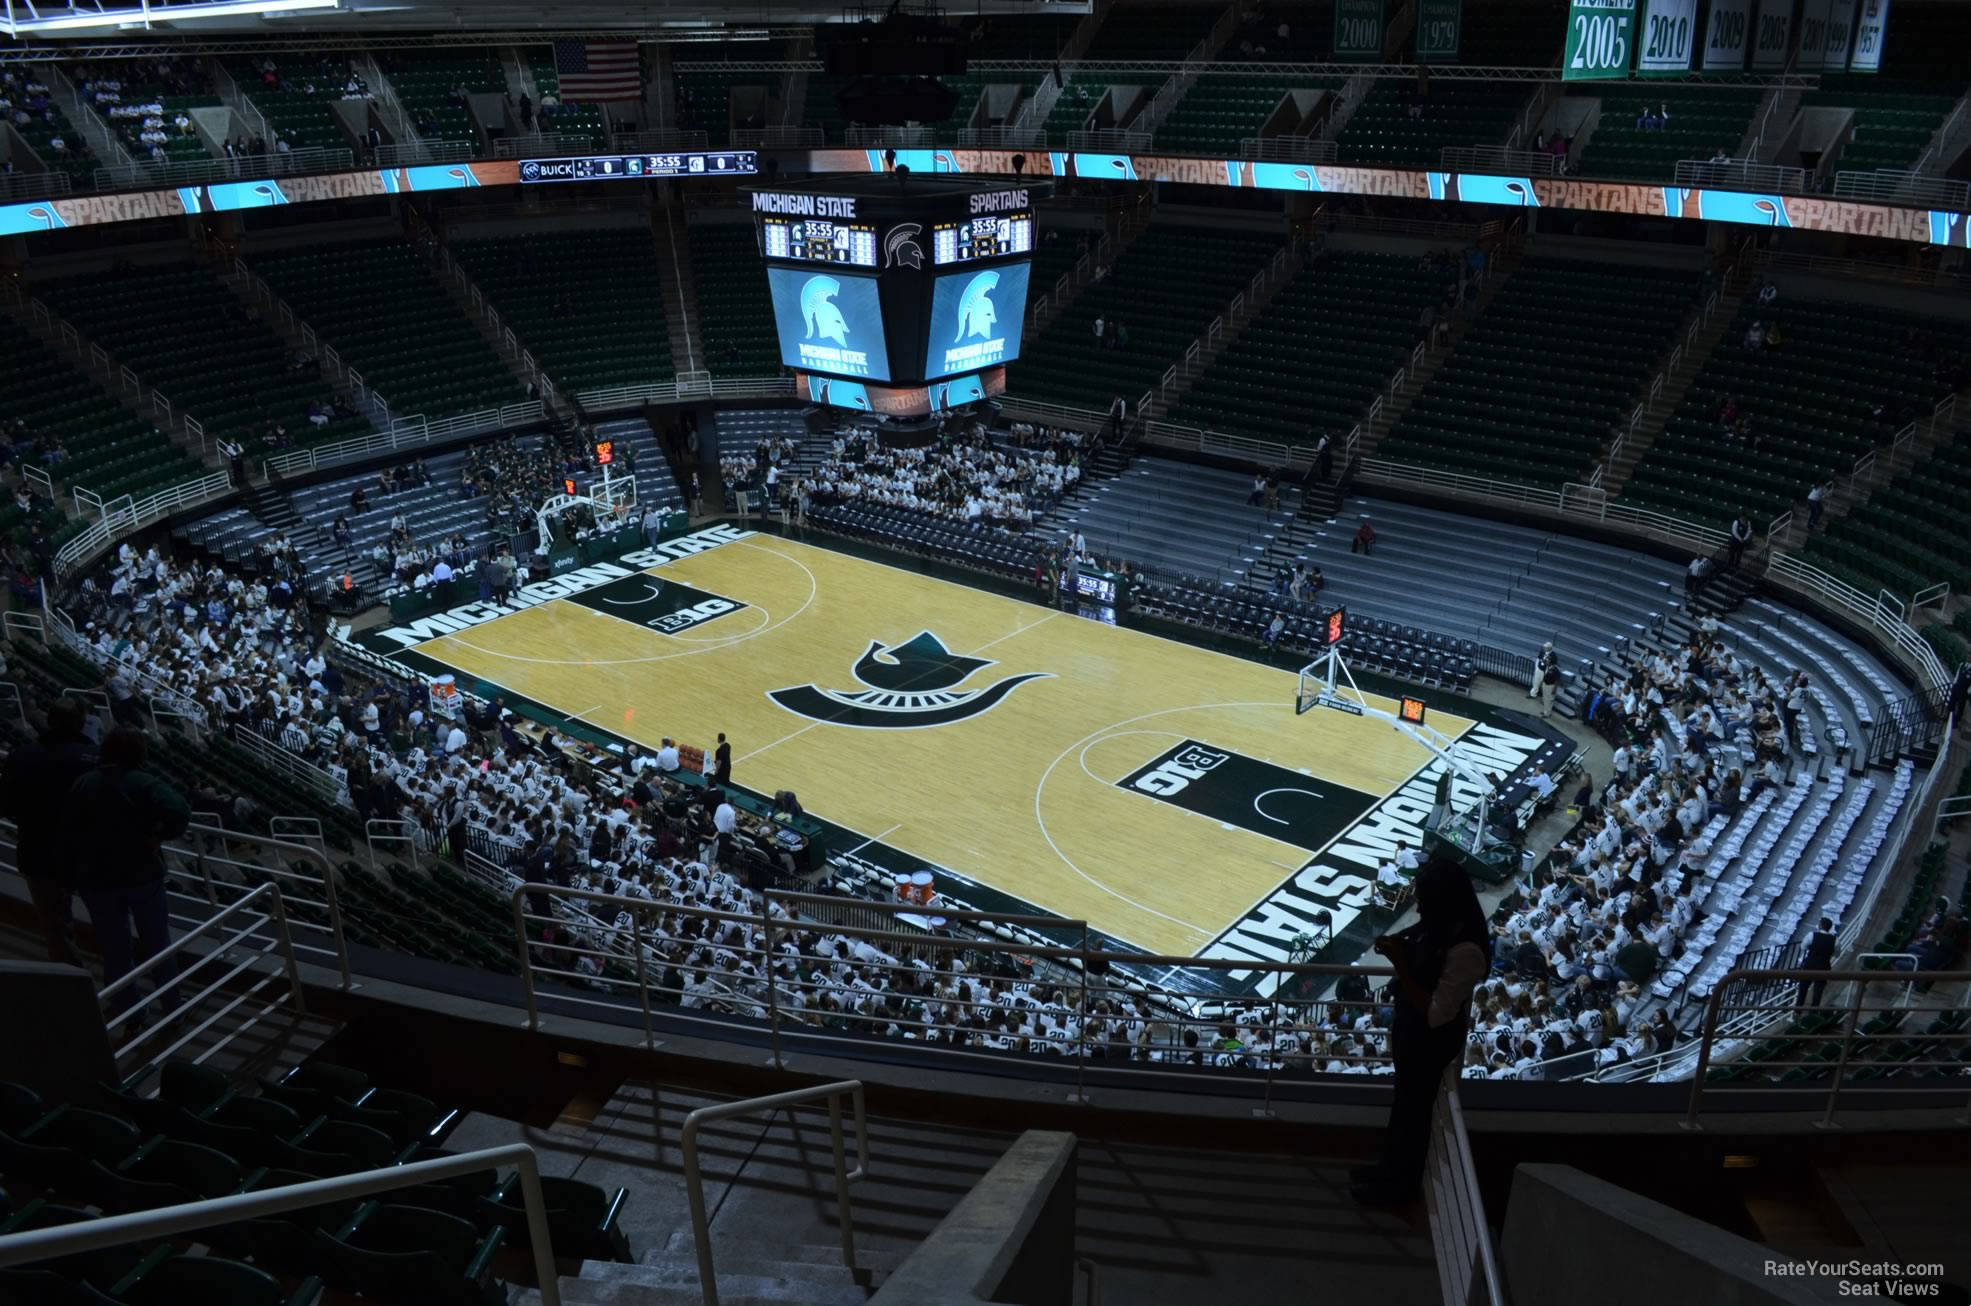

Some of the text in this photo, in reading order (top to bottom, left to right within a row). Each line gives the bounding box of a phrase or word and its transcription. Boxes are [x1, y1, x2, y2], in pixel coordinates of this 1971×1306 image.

[1340, 17, 1377, 48] 2000
[1423, 21, 1455, 48] 1979
[1571, 14, 1627, 69] 2005
[1647, 15, 1687, 58] 2010
[1711, 9, 1744, 49] 2009
[1760, 15, 1786, 50] 2005
[540, 164, 573, 176] BUICK
[604, 161, 612, 173] 0
[650, 156, 681, 167] 35:55
[717, 157, 725, 168] 0
[1134, 157, 1228, 186] SPARTANS
[282, 170, 386, 203] SPARTANS
[1318, 168, 1429, 199] SPARTANS
[57, 190, 185, 227] SPARTANS
[752, 192, 856, 218] MICHIGAN STATE
[970, 189, 1028, 214] SPARTANS
[1534, 179, 1664, 216] SPARTANS
[805, 222, 832, 236] 35:55
[973, 219, 996, 233] 35:55
[1786, 198, 1931, 243] SPARTANS
[874, 386, 928, 411] SPARTANS
[619, 523, 758, 568] STATE
[554, 556, 574, 568] xfinity
[1078, 576, 1097, 589] 35:55
[616, 912, 630, 925] 20
[715, 952, 729, 967] 20
[1015, 982, 1029, 993] 20
[1031, 1041, 1047, 1053] 20
[1280, 1040, 1295, 1051] 20
